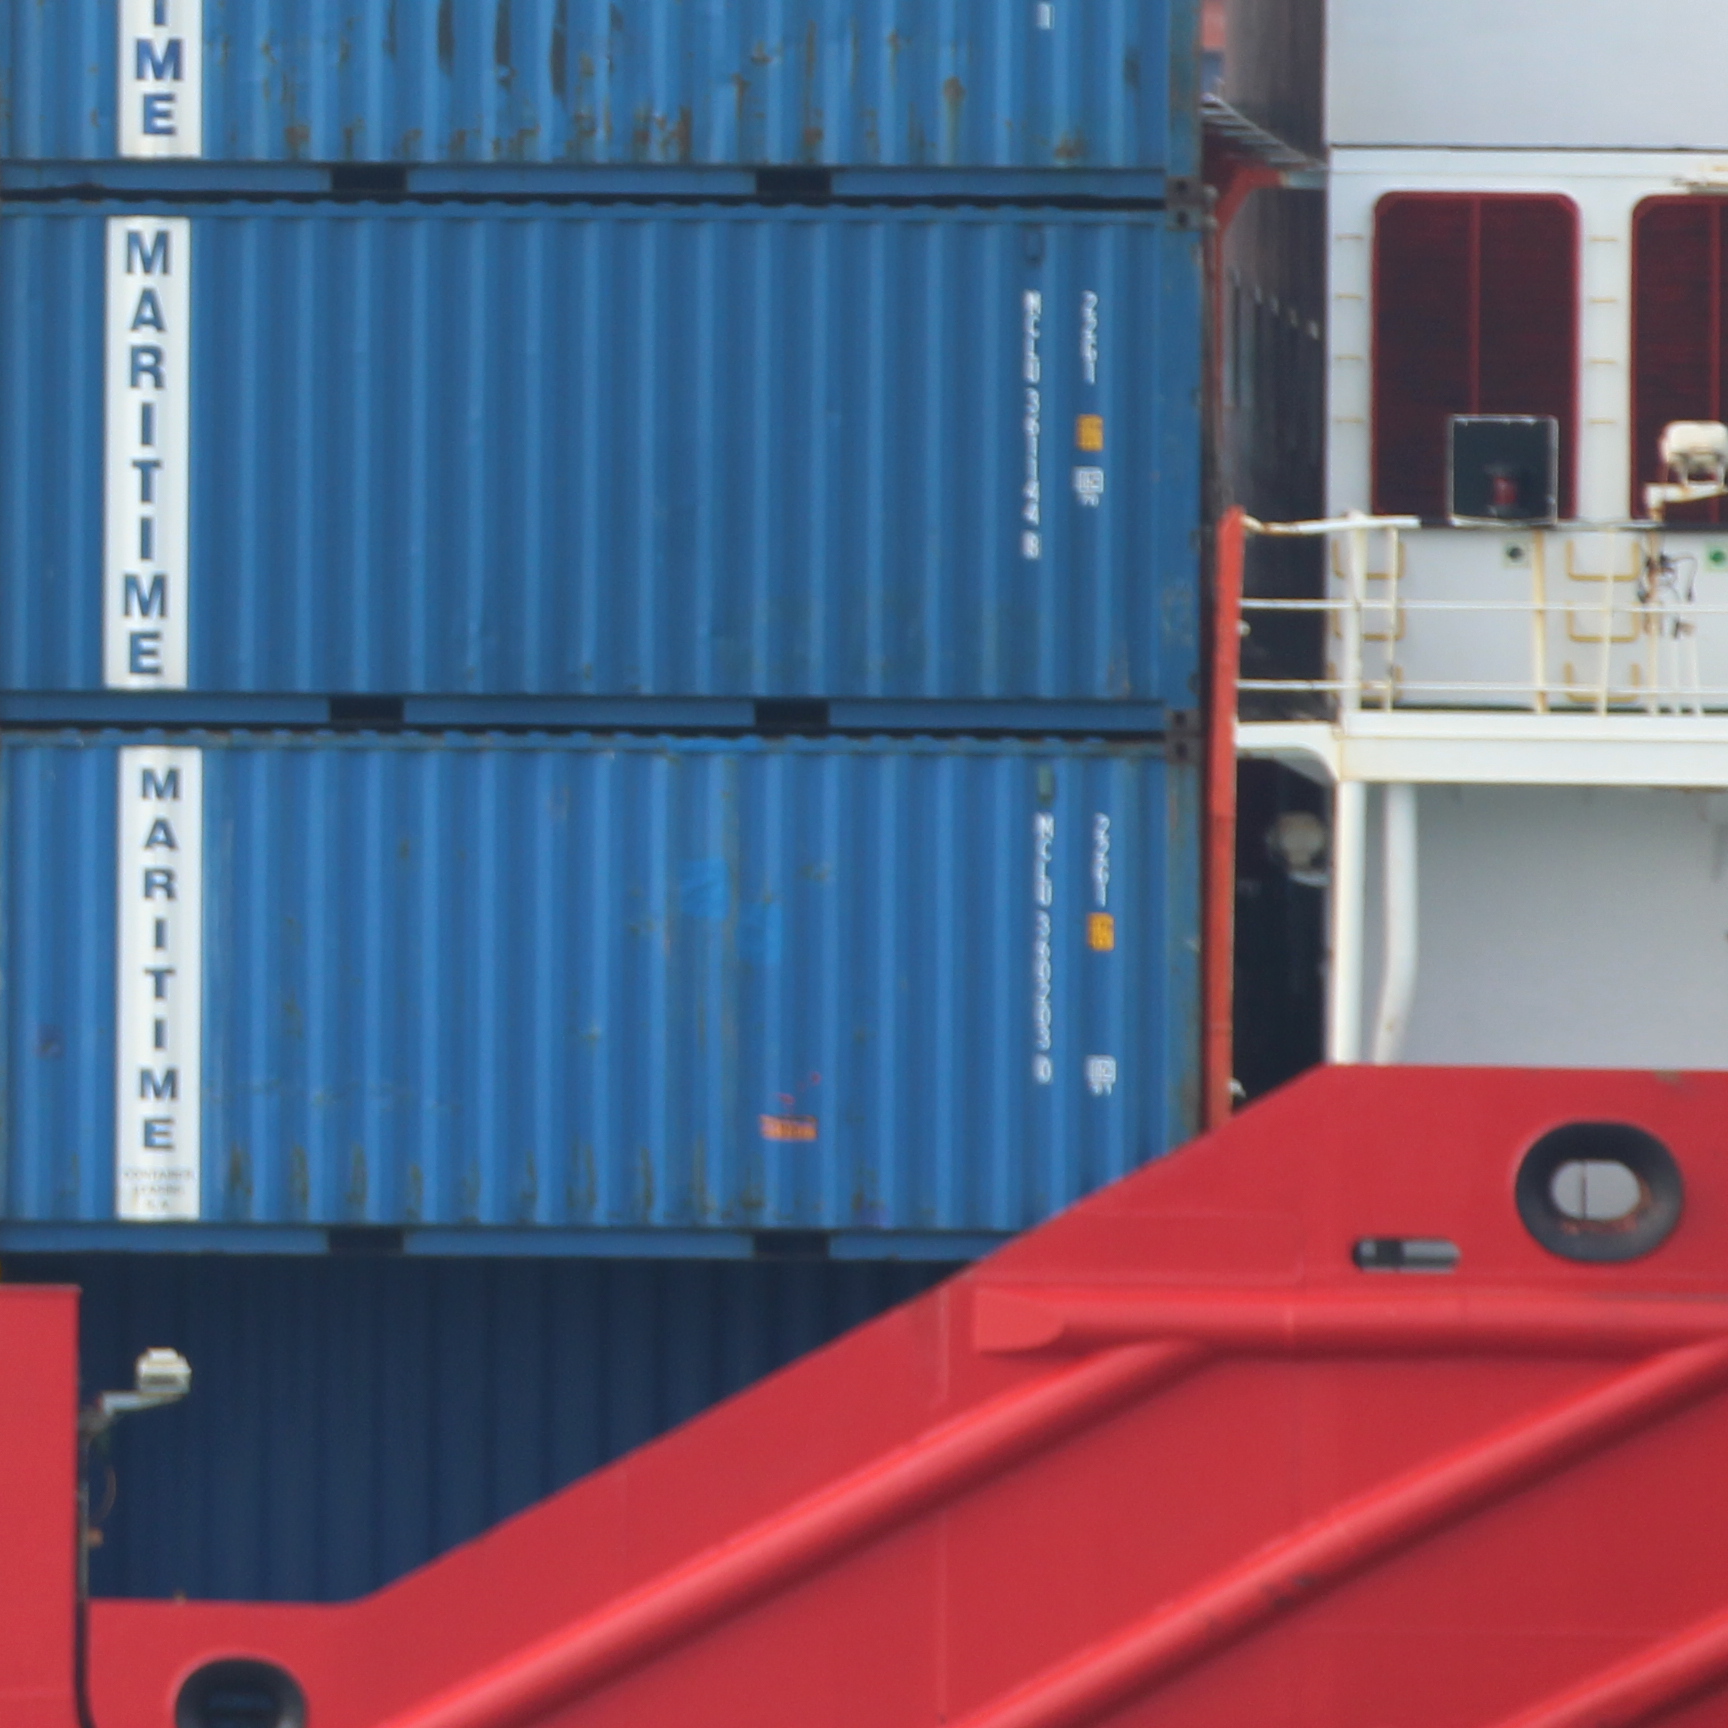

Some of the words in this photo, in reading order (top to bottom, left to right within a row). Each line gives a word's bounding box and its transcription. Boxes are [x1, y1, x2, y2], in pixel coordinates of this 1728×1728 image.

[1024, 292, 1042, 384] MCLU
[1083, 292, 1098, 384] 22G1
[122, 228, 171, 678] MARITIME
[139, 766, 181, 1152] MARITIME
[1035, 1055, 1053, 1084] 0
